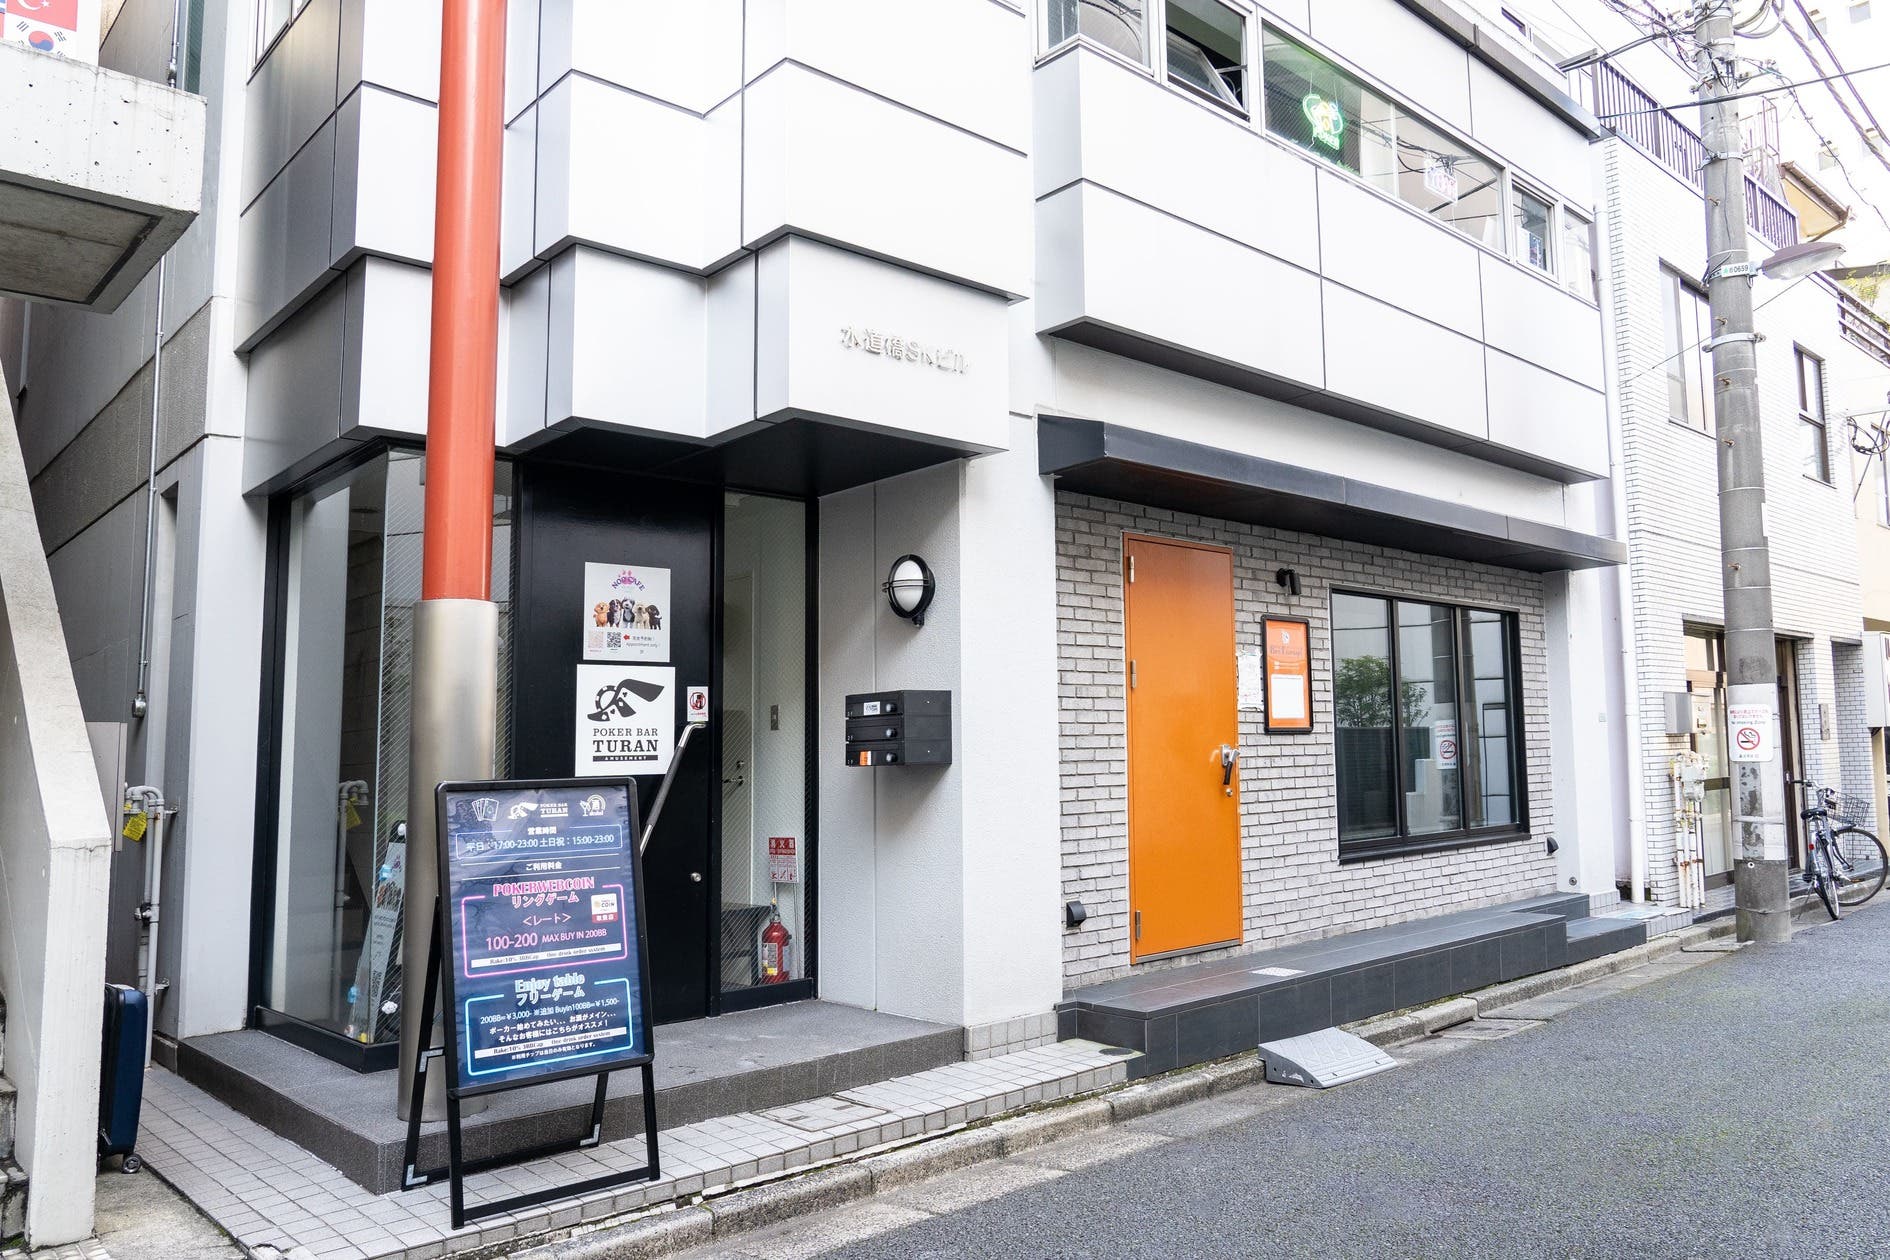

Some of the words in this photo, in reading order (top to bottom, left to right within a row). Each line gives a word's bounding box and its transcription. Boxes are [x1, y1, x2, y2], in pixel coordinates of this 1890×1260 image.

[593, 728, 632, 737] POKER
[636, 728, 658, 737] BAR
[592, 740, 658, 753] TURAN
[528, 826, 557, 836] 営業時間
[525, 861, 562, 870] ご利用料金
[492, 876, 595, 897] POKERWEBCOIN
[512, 892, 580, 909] リングゲーム
[485, 933, 538, 951] 100-200
[542, 935, 559, 944] MAX
[560, 933, 576, 941] BUY
[585, 928, 607, 938] 200BB
[514, 977, 550, 993] Enjoy
[553, 972, 585, 987] table
[516, 986, 585, 1006] フリーゲーム
